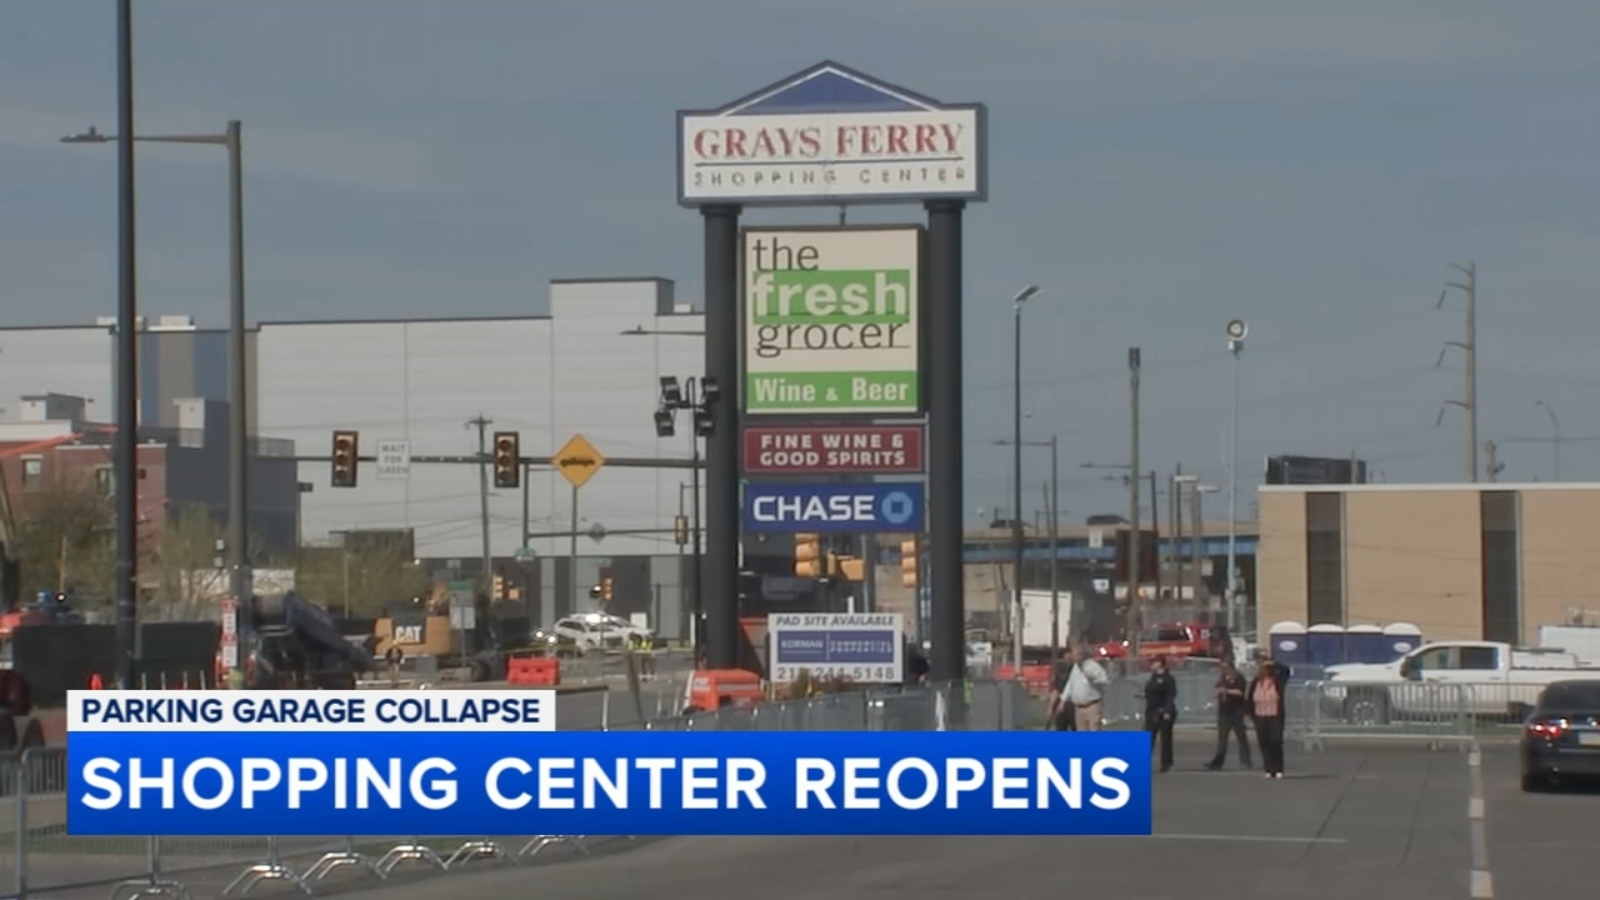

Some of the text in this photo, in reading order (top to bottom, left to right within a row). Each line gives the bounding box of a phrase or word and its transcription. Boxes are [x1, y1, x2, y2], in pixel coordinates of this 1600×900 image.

[694, 122, 964, 158] GRAYS FERRY
[694, 167, 965, 187] SHOPPING CENTER
[752, 237, 819, 272] the
[752, 271, 907, 316] fresh
[756, 323, 903, 358] grocer
[754, 377, 909, 402] Wine & Beer
[761, 434, 904, 449] FINE WINE &
[760, 451, 905, 466] GOOD SPIRITS
[753, 495, 875, 521] CHASE
[776, 616, 894, 626] PAD SITE AVAILABLE
[395, 625, 421, 643] CAT
